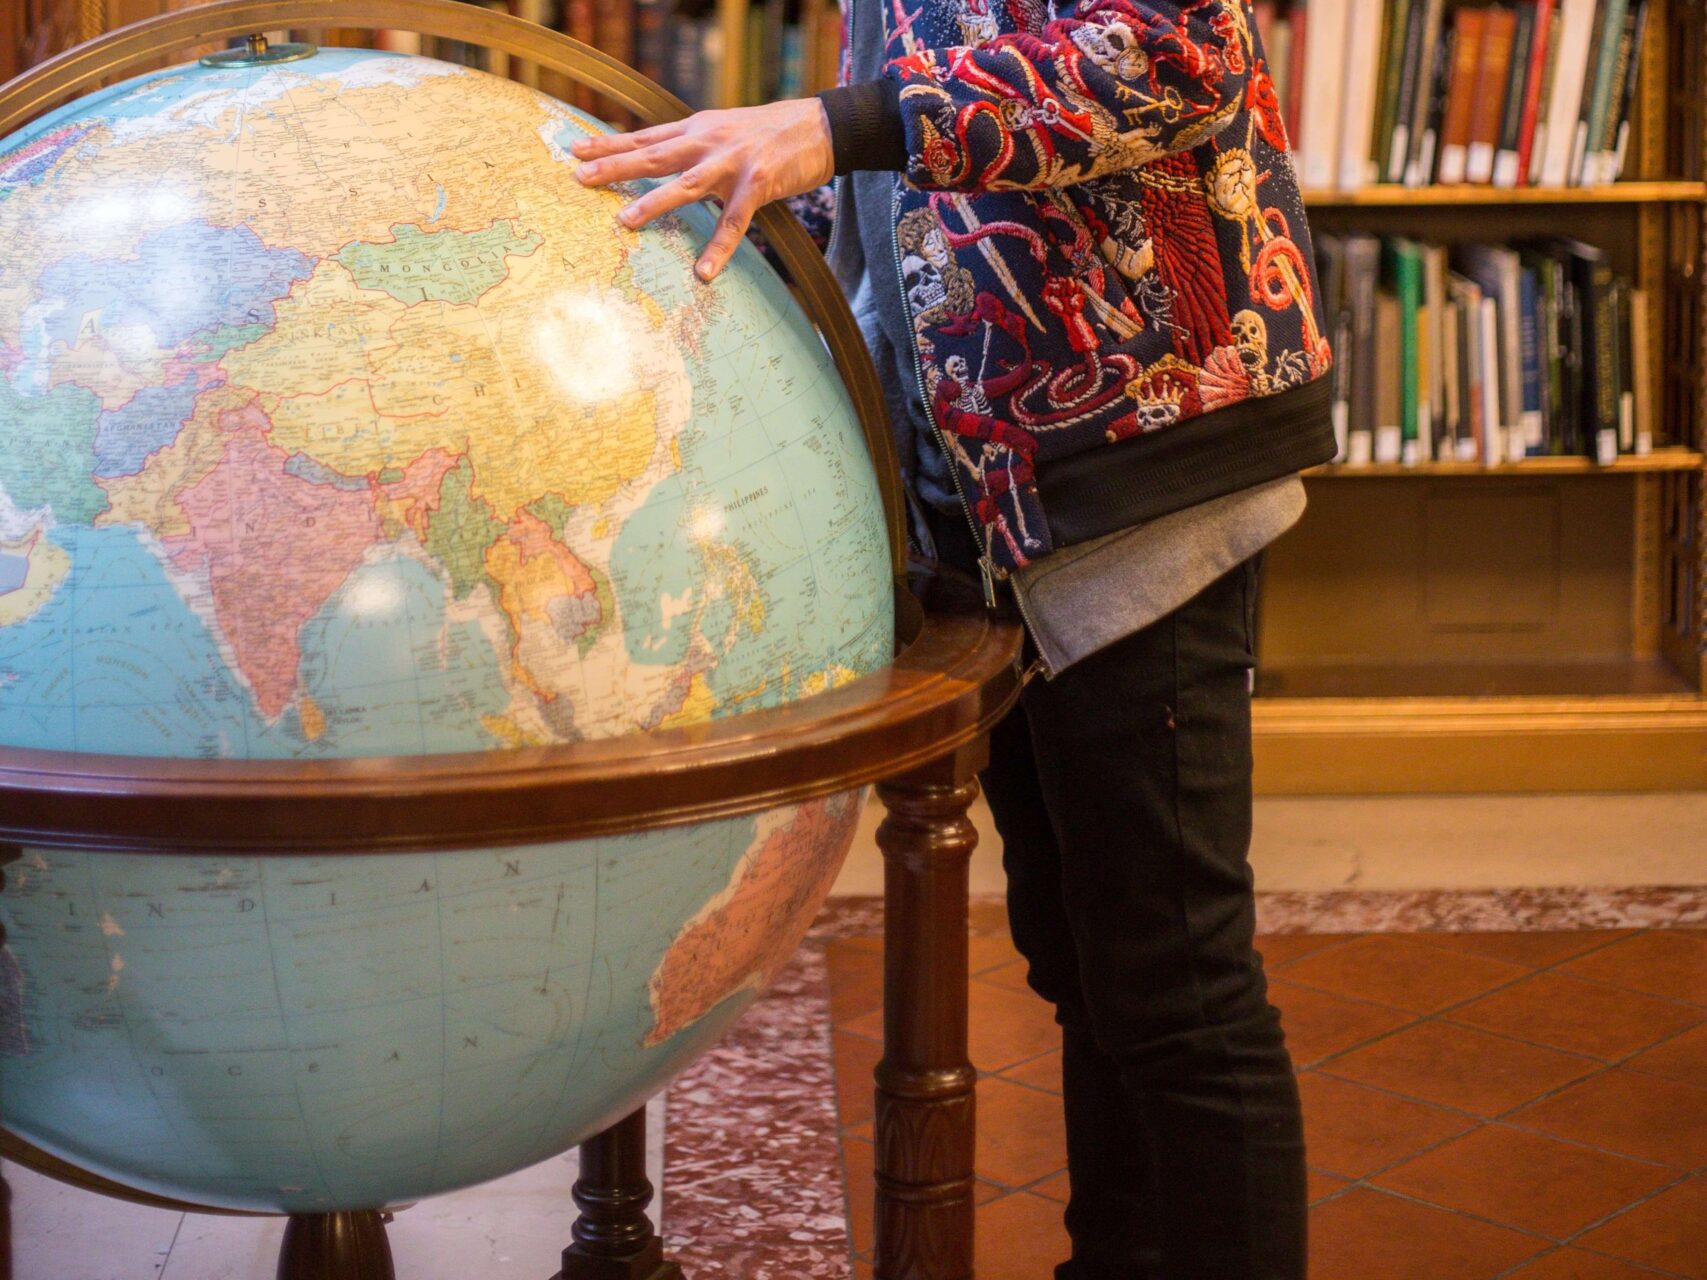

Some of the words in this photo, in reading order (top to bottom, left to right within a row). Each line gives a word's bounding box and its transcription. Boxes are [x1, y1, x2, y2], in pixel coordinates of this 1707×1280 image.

[380, 245, 512, 272] MONGOLIA
[724, 485, 769, 513] PHILIPPINES
[67, 859, 520, 919] INDIAN
[150, 1035, 479, 1077] OCEAN
